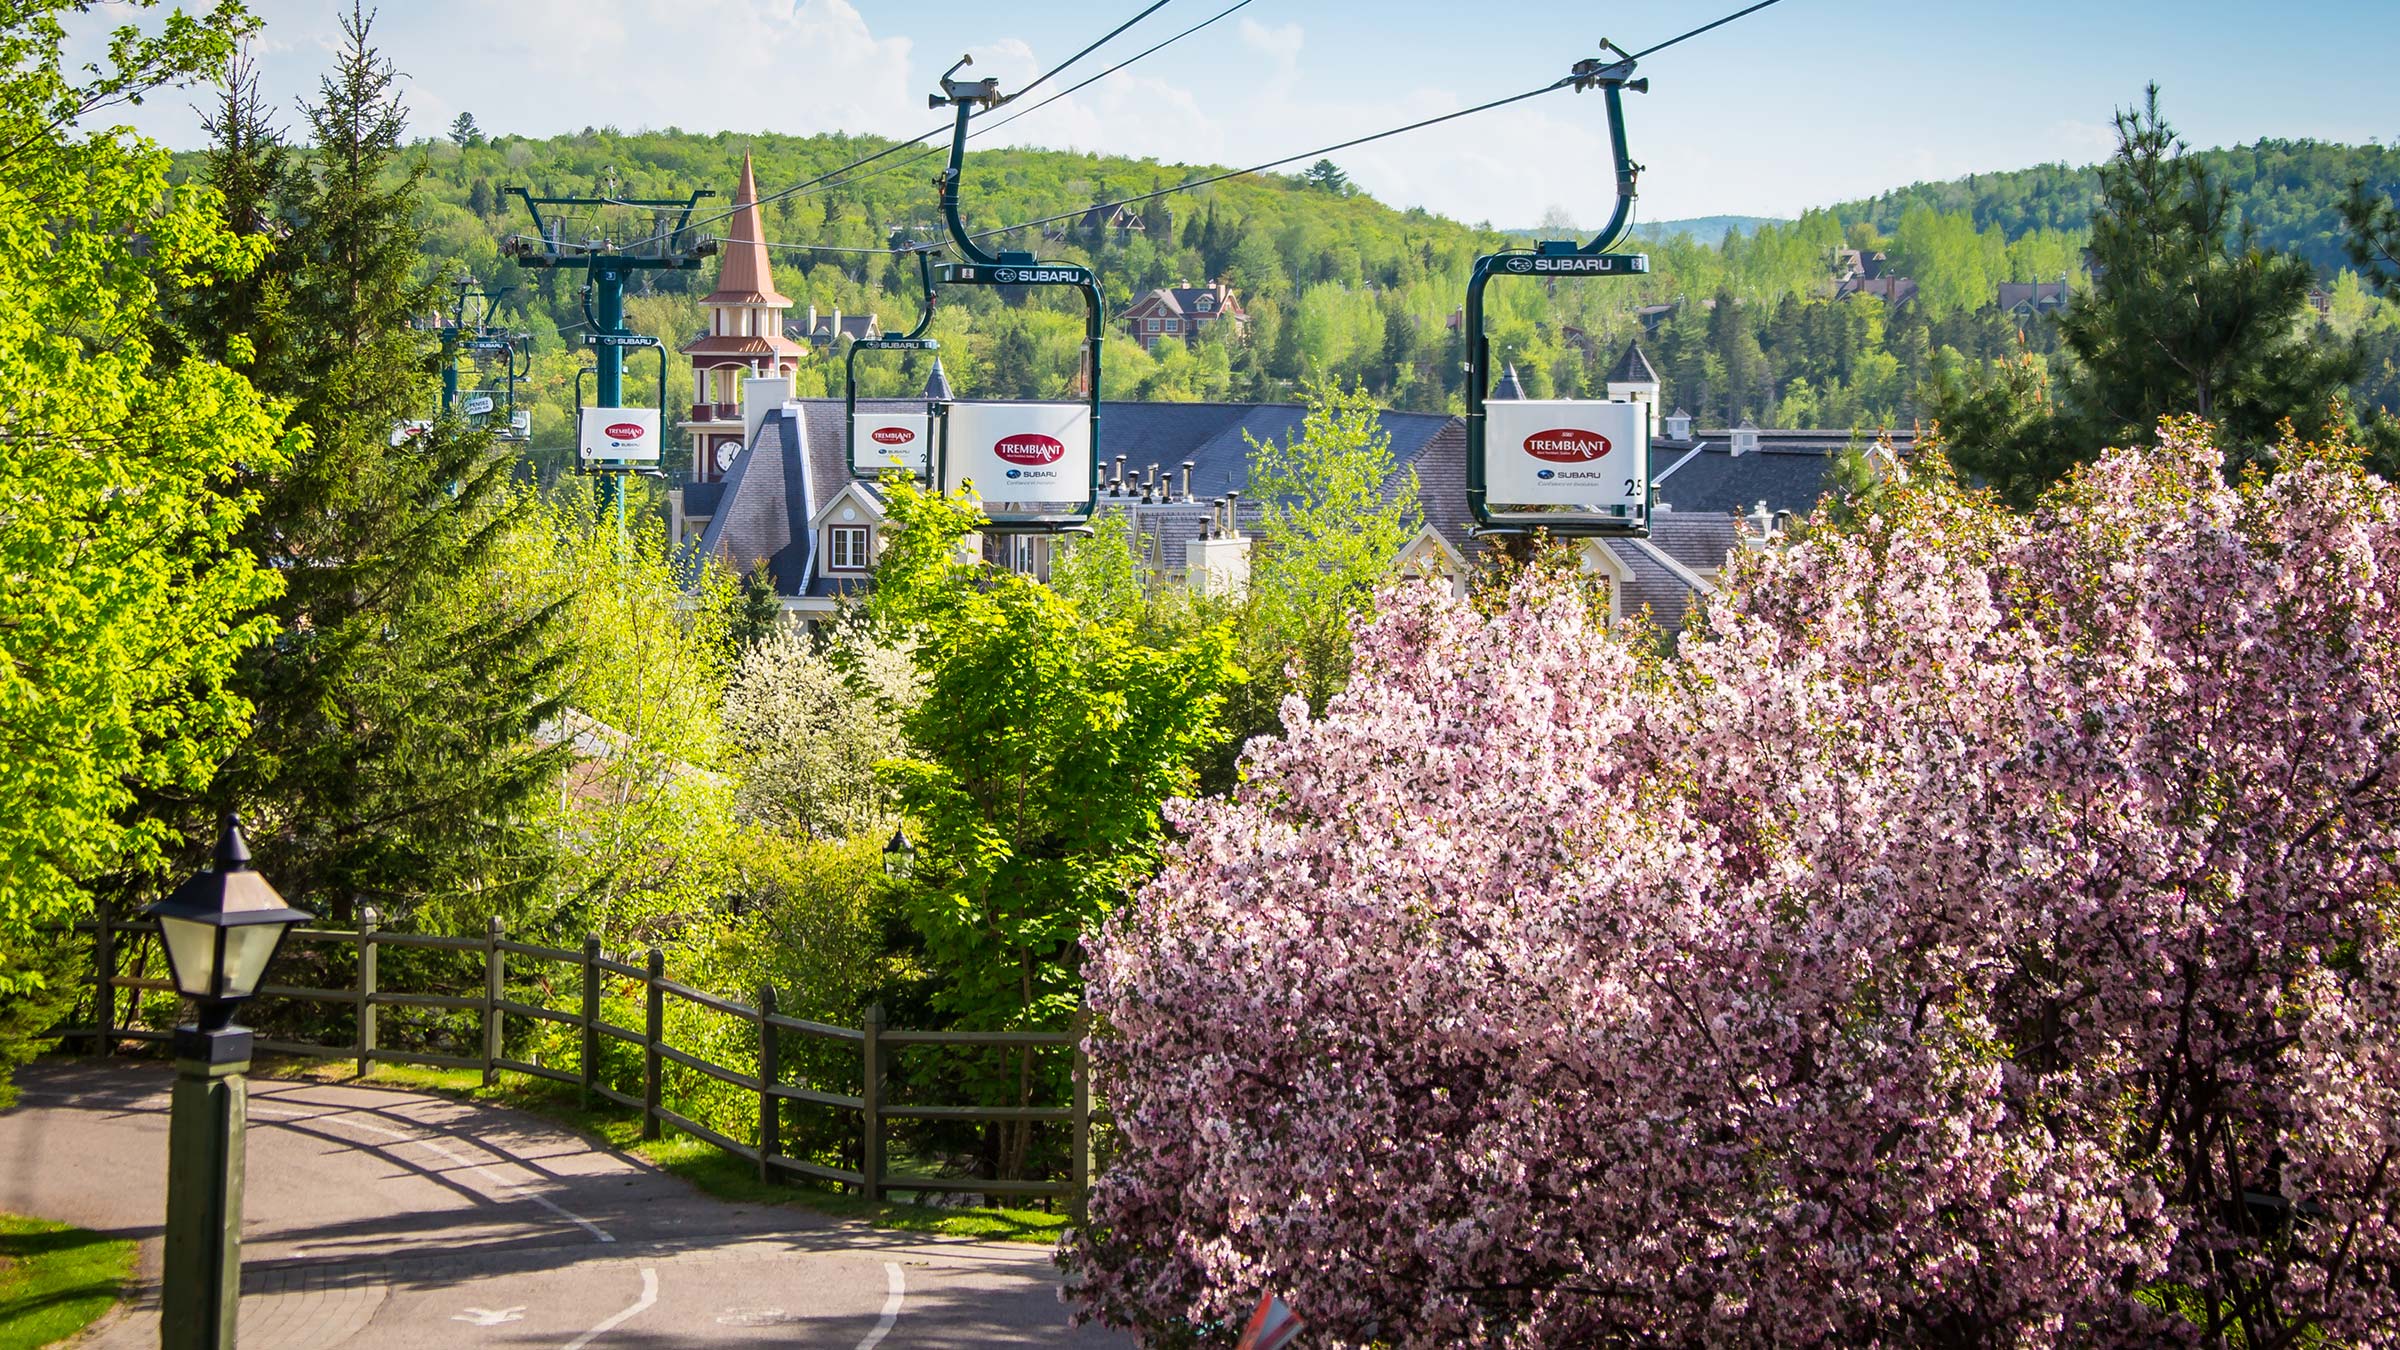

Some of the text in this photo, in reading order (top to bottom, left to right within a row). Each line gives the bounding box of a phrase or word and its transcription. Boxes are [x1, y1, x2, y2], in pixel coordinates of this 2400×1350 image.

[1535, 259, 1612, 271] SUBARU
[1018, 270, 1079, 282] SUBARU
[880, 341, 920, 349] SUBARU
[608, 428, 642, 438] TREMBLANT
[875, 432, 912, 443] TREMBLANT
[586, 447, 592, 456] 9
[1001, 443, 1061, 462] TREMBLANT
[1529, 439, 1605, 458] TREMBLANT
[1624, 479, 1643, 497] 25
